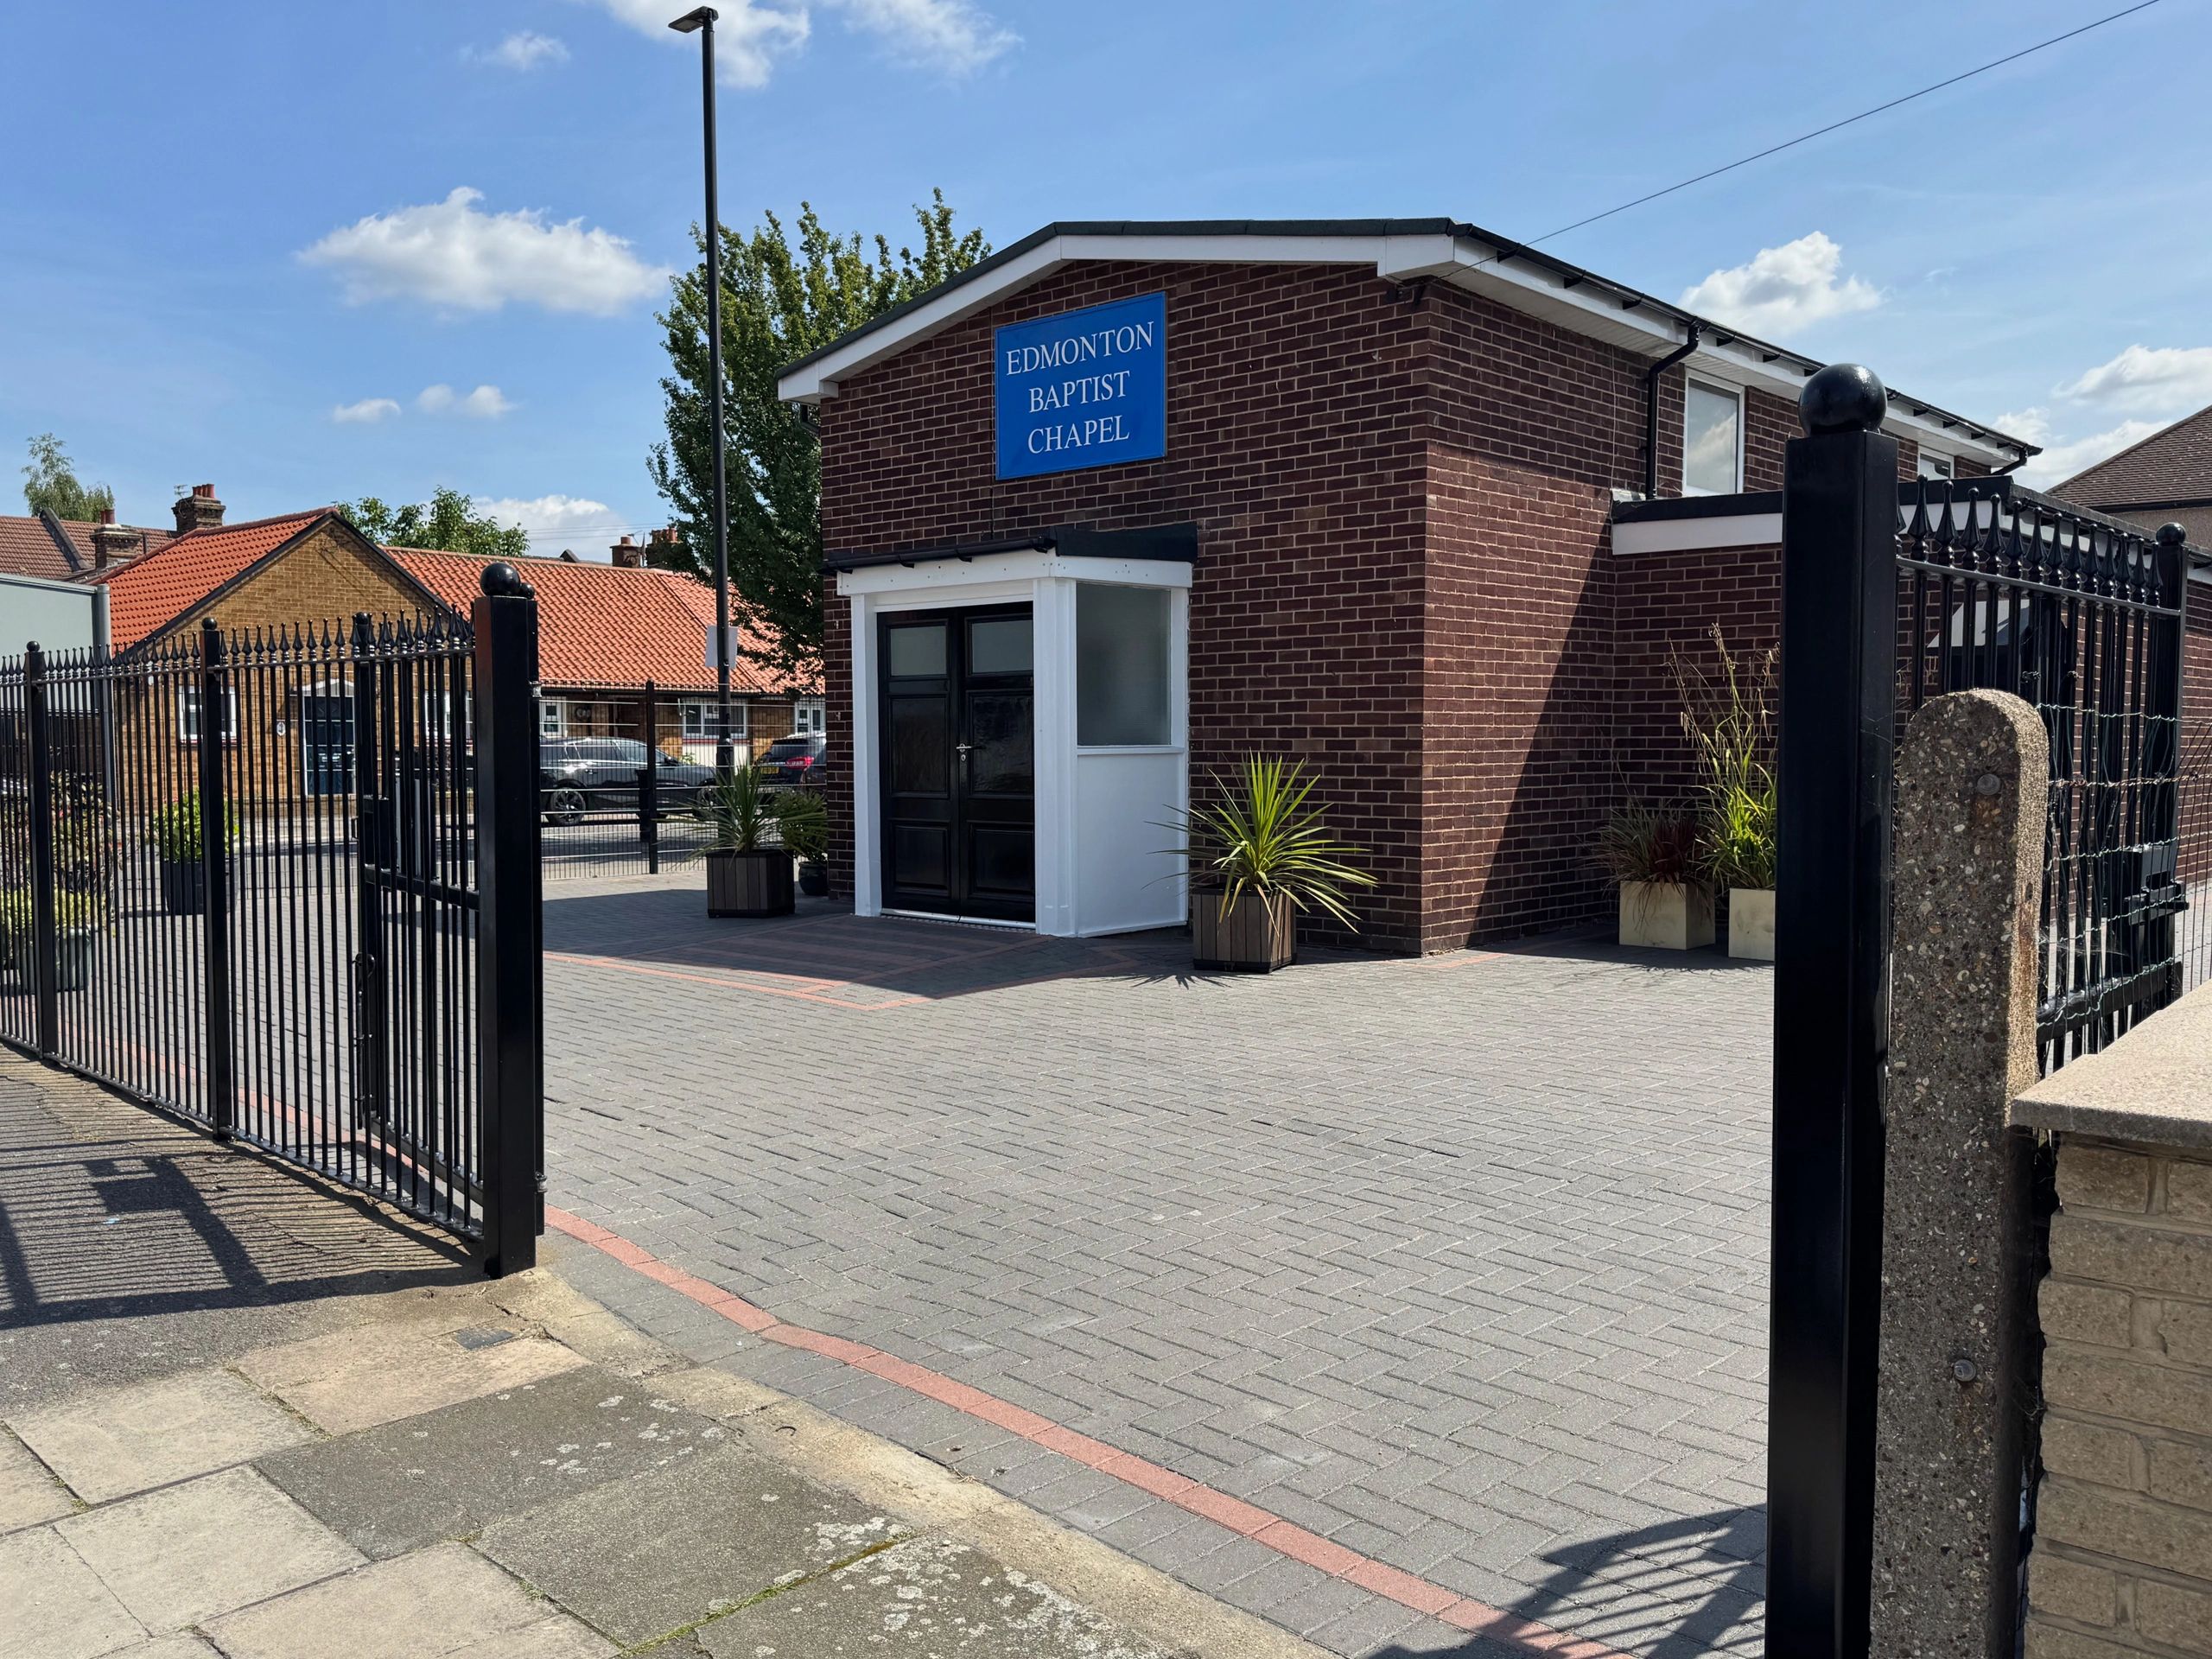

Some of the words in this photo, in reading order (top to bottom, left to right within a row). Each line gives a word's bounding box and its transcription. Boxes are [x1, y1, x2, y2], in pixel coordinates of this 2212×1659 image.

[1006, 321, 1154, 376] EDMONTON
[1028, 370, 1130, 413] BAPTIST
[1027, 415, 1130, 454] CHAPEL
